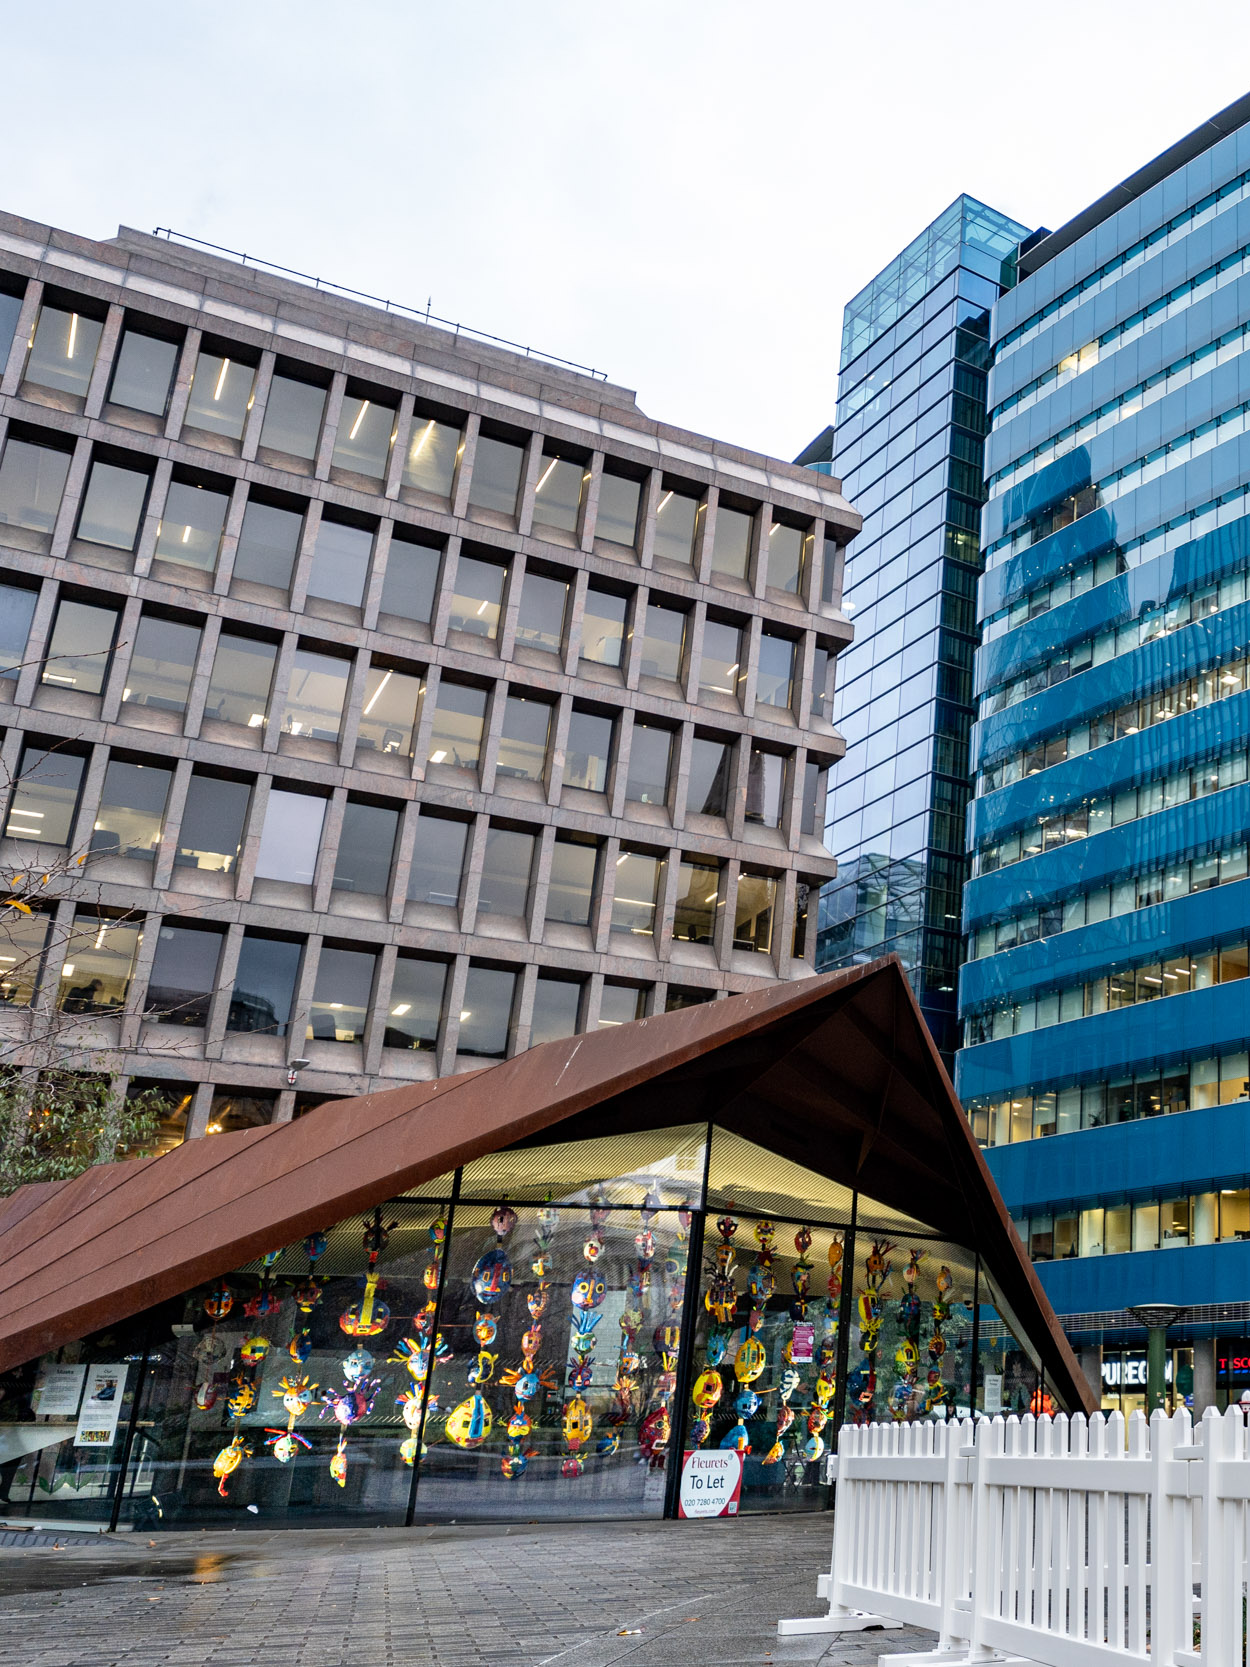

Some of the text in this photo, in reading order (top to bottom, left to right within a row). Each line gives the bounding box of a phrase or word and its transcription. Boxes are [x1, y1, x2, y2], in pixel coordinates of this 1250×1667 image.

[1101, 1360, 1173, 1386] PUREGM
[691, 1456, 729, 1469] Fleurets
[690, 1474, 725, 1490] To Let
[684, 1497, 726, 1507] 020 7280 4700
